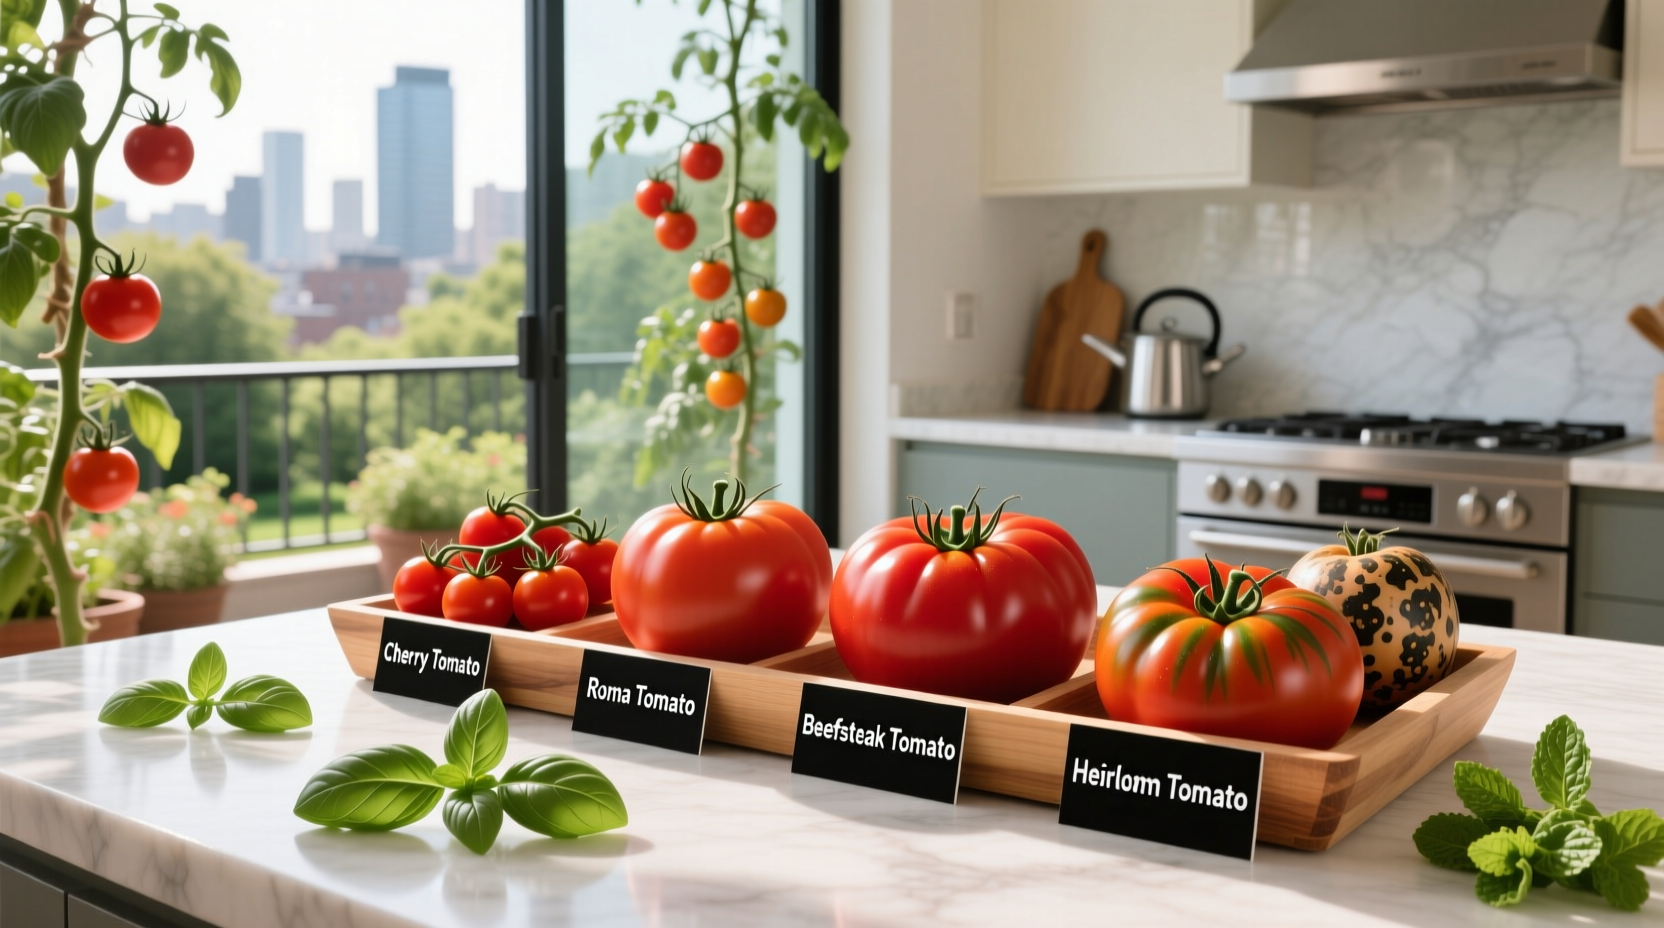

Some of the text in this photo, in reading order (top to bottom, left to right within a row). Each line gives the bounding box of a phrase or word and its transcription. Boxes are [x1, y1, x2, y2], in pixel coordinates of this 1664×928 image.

[383, 641, 481, 677] Cherry Tomato
[586, 676, 696, 716] Roma Tomato
[801, 713, 956, 761] Beefsteak Tomato
[1167, 773, 1248, 812] Tomato
